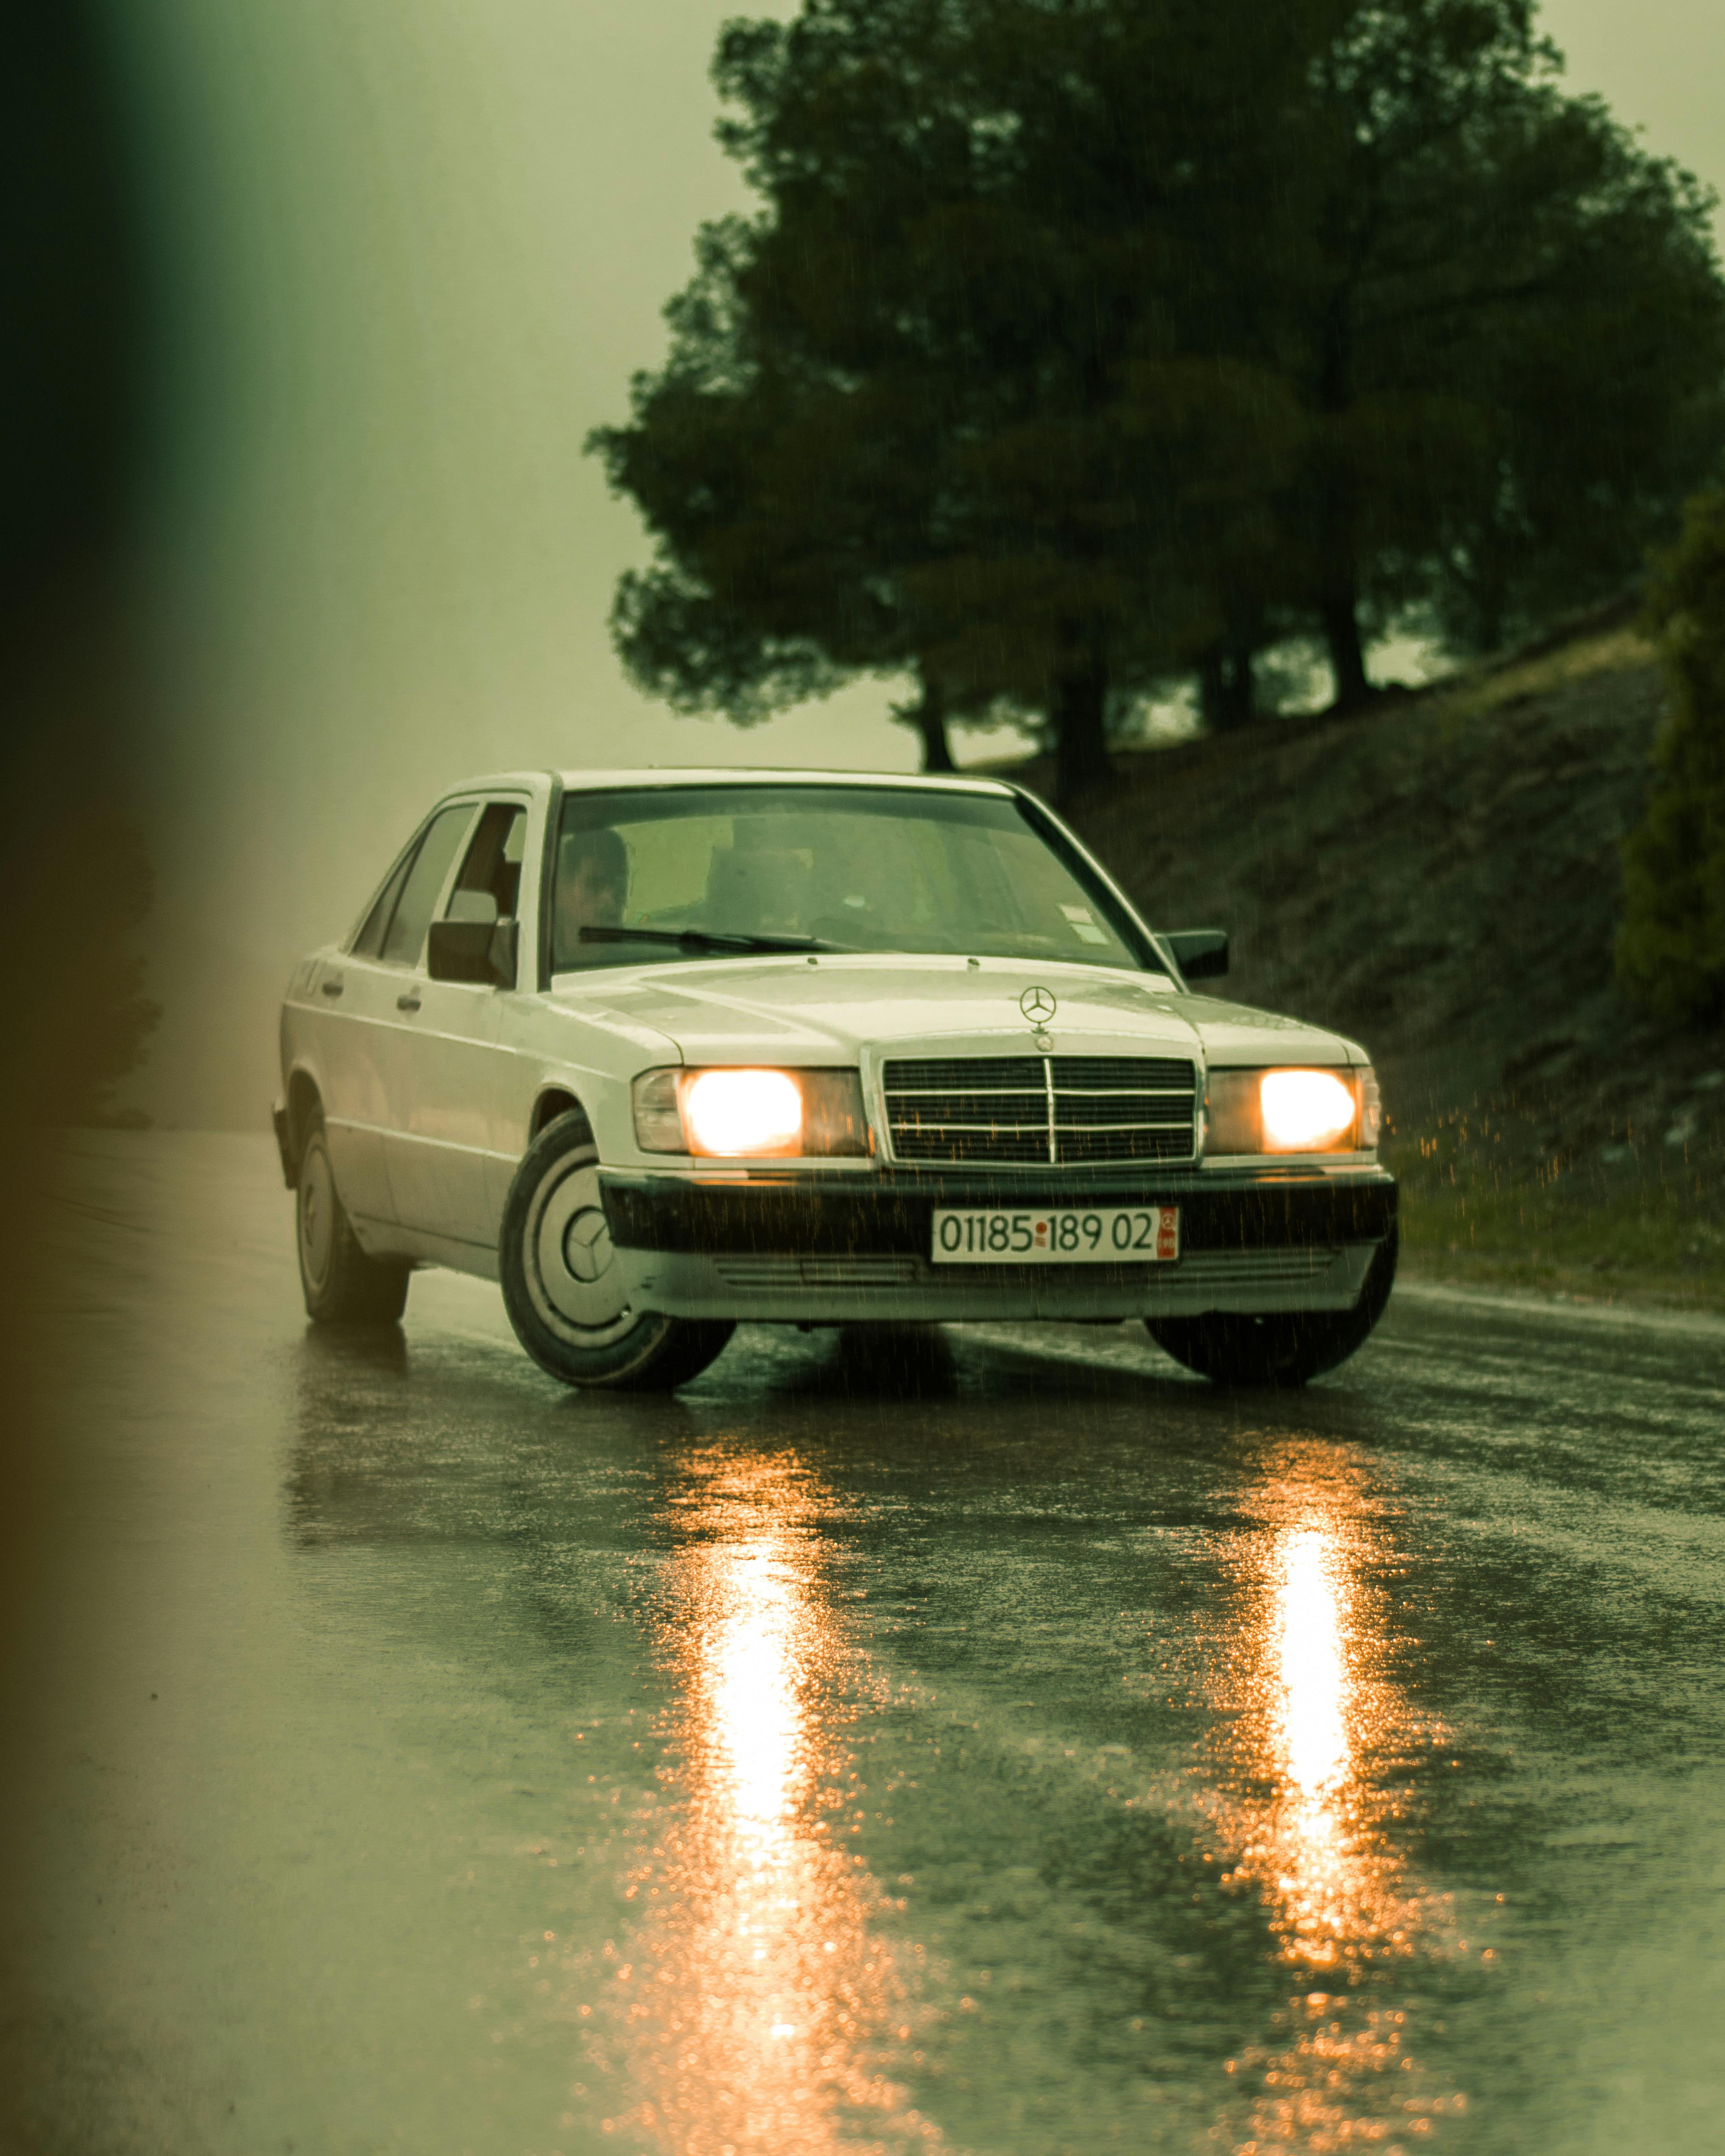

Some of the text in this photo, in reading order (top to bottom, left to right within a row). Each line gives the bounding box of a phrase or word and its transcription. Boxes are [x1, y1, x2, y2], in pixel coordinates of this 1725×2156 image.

[939, 1212, 1152, 1252] 01185 189 02
